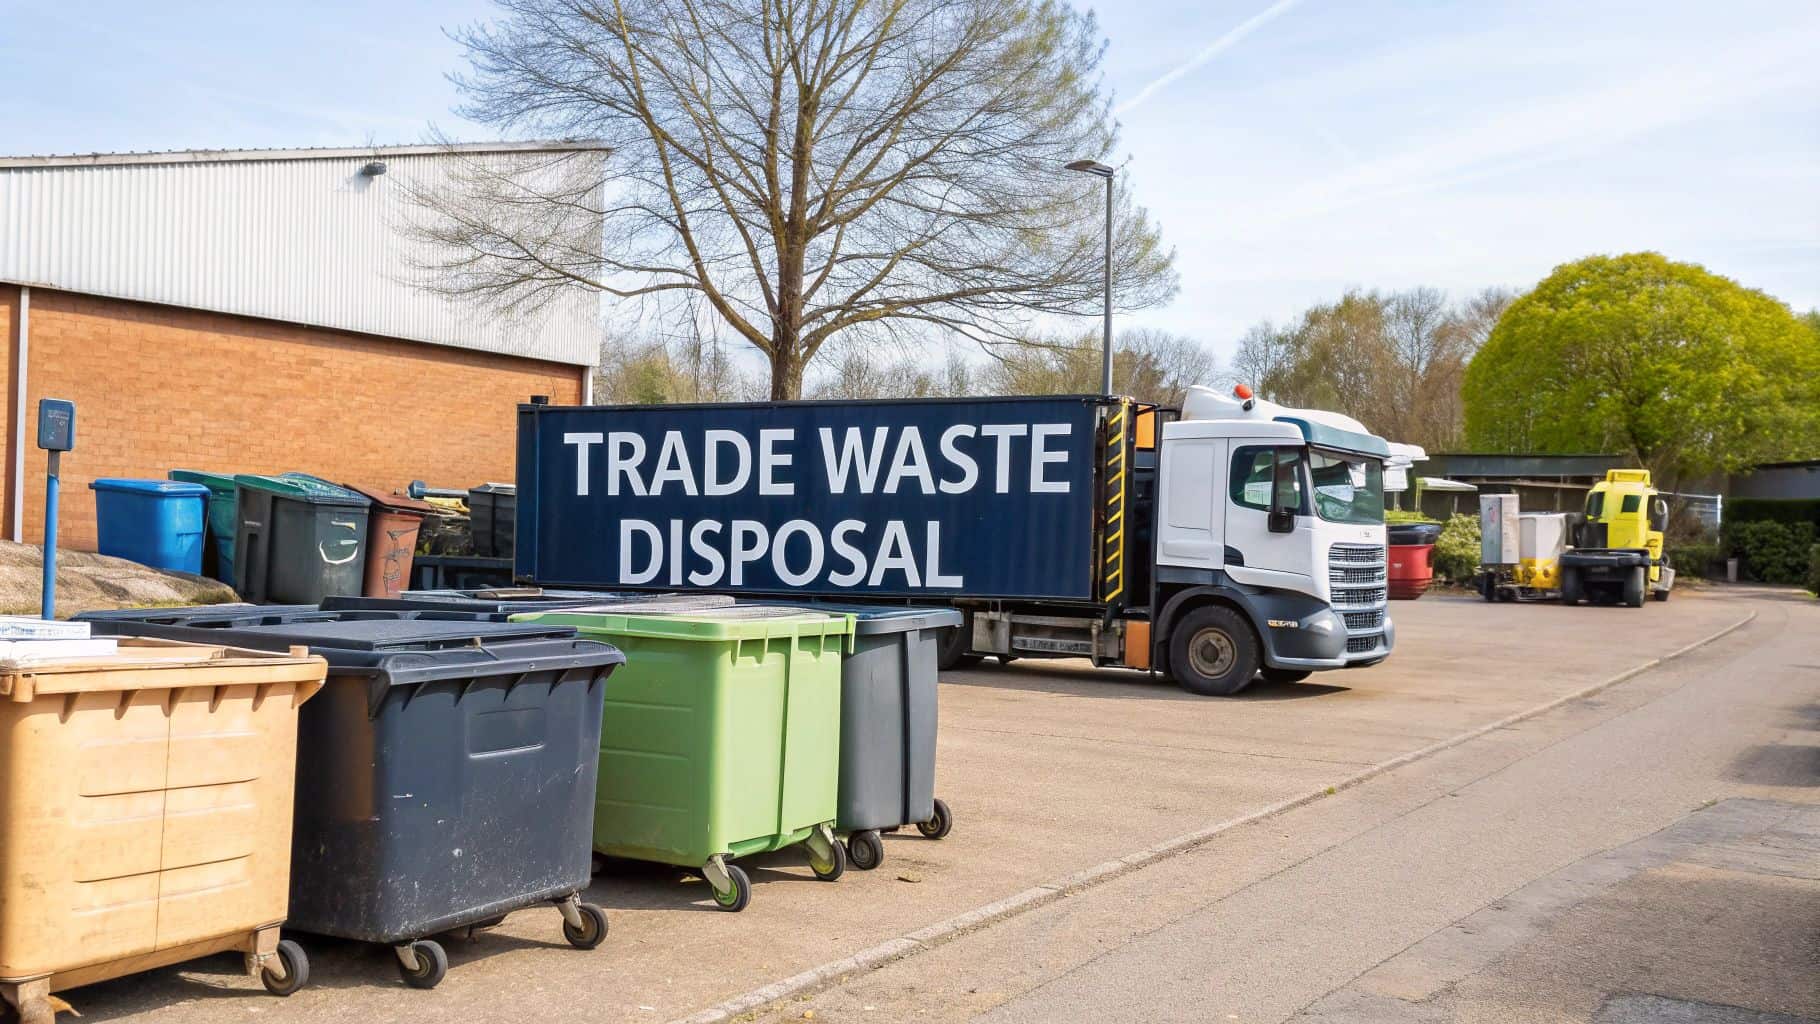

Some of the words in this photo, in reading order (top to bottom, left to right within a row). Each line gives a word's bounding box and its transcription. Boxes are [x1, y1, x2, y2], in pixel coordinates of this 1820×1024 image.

[564, 429, 795, 496] TRADE
[819, 423, 1072, 495] WASTE
[619, 519, 963, 587] DISPOSAL
